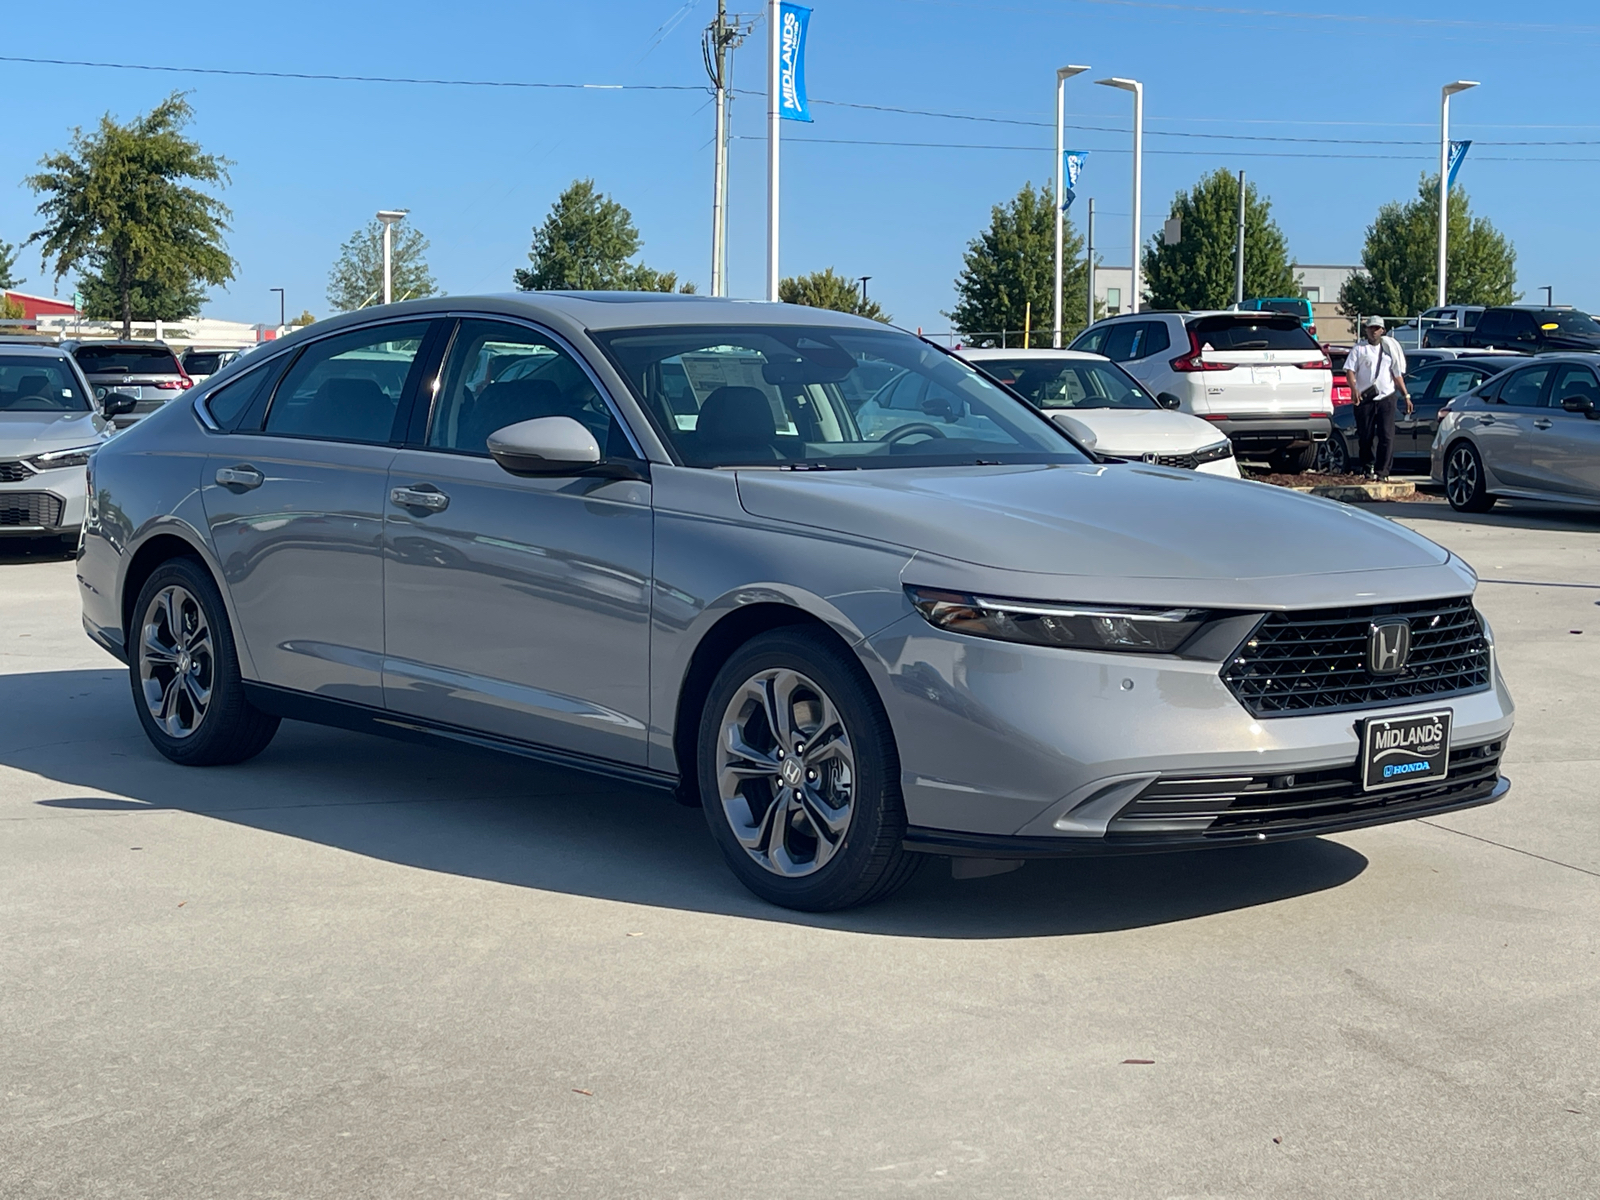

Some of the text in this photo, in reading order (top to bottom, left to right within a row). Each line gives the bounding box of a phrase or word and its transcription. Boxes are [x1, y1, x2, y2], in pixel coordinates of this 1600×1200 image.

[782, 12, 796, 109] MIDLANDS
[1375, 723, 1443, 750] MIDLANDS
[1393, 761, 1431, 775] HONDA
